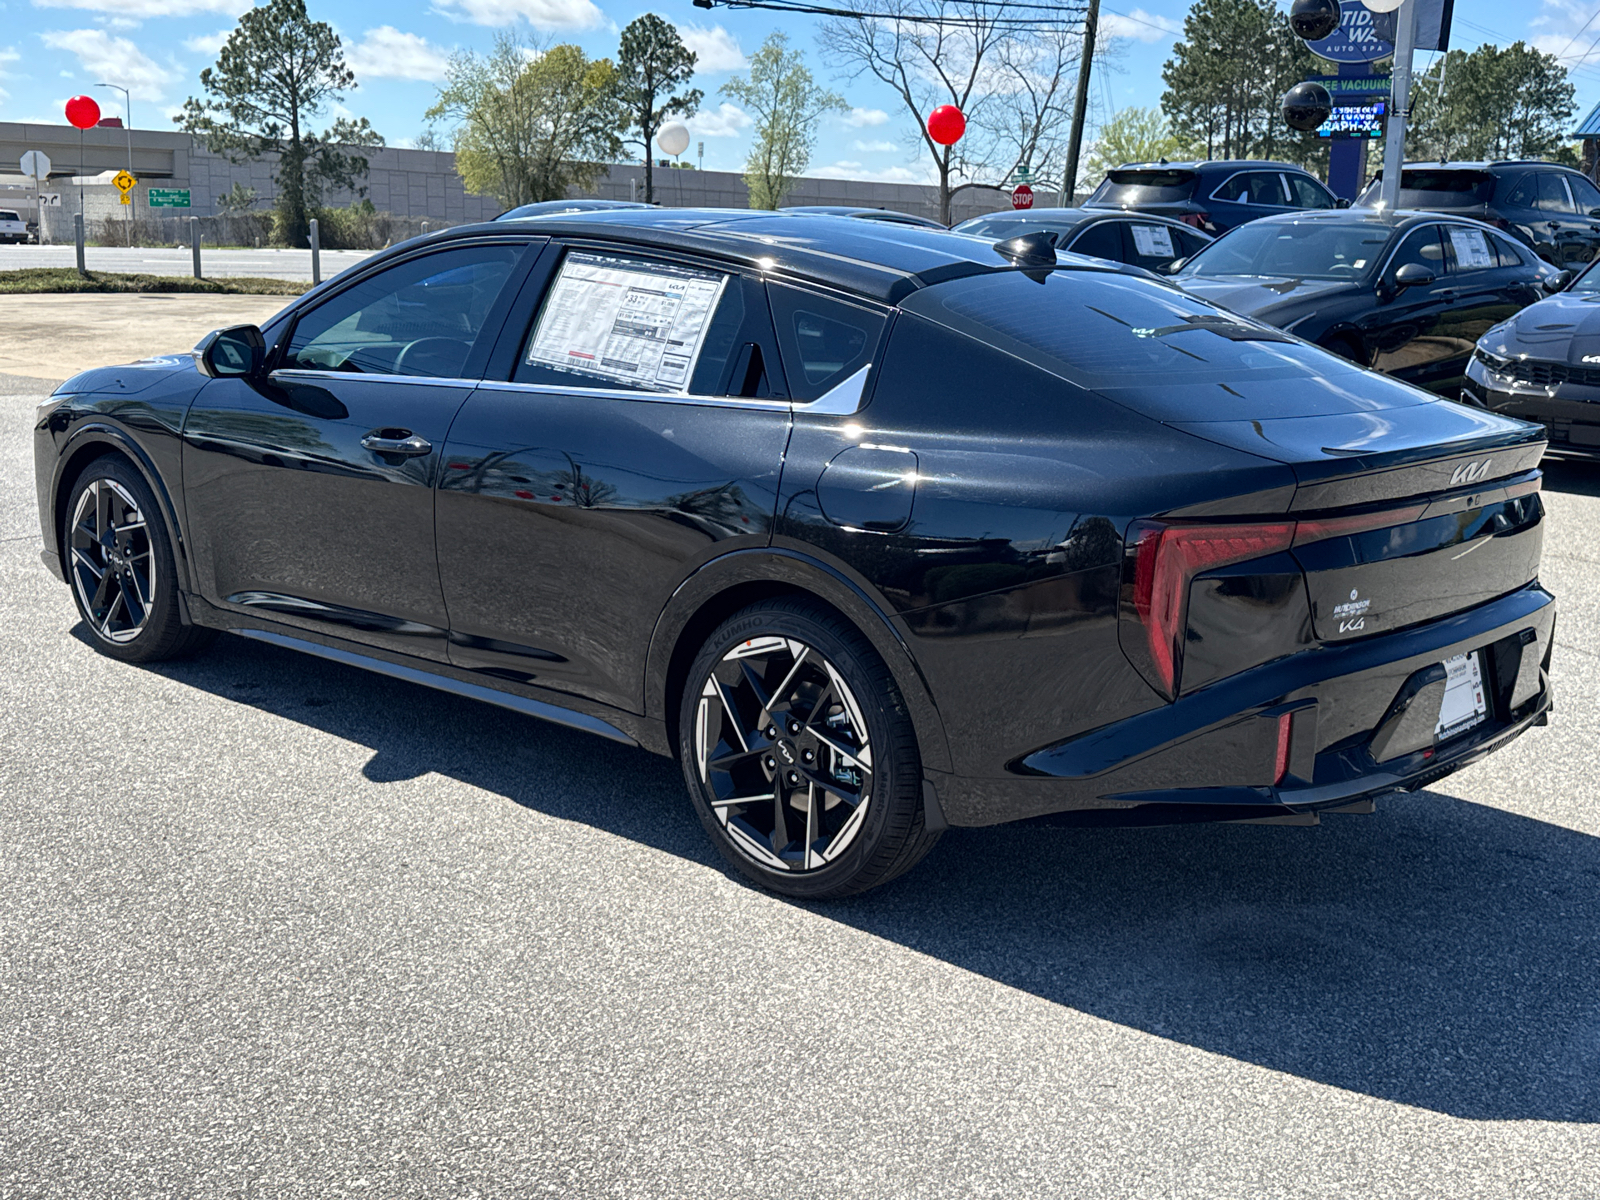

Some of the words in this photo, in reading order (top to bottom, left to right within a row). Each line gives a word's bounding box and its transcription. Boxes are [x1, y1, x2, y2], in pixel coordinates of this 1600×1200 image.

[1349, 27, 1378, 43] WA
[1341, 79, 1391, 90] VACUUMS
[1013, 193, 1033, 205] STOP
[1450, 459, 1491, 484] KIA
[714, 617, 762, 648] KUMHO
[1339, 617, 1365, 633] K4
